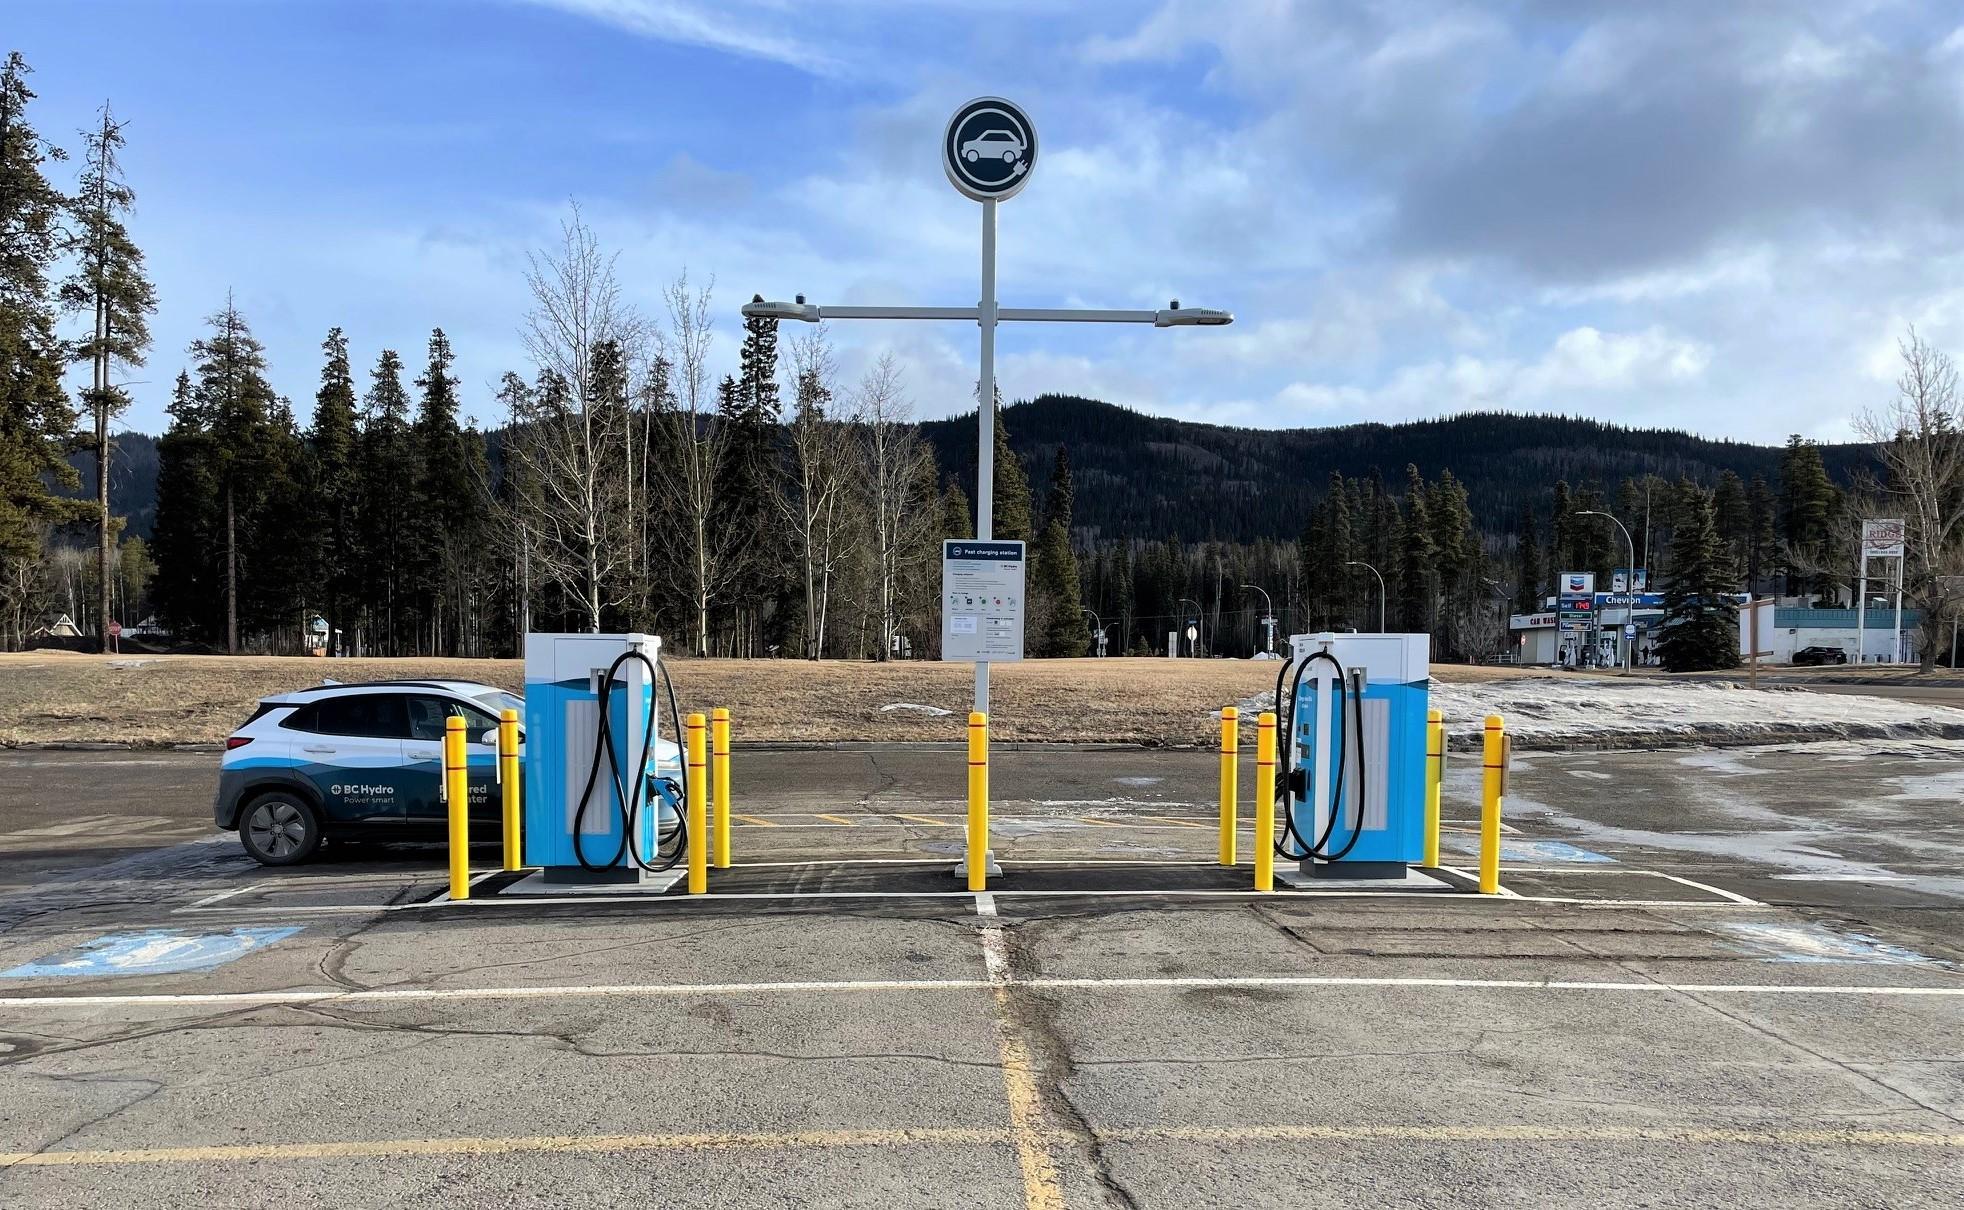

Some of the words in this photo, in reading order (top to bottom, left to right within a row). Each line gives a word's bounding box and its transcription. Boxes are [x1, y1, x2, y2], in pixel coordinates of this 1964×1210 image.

[344, 785, 359, 794] BC
[361, 784, 394, 796] Hydro
[440, 784, 487, 794] Pred
